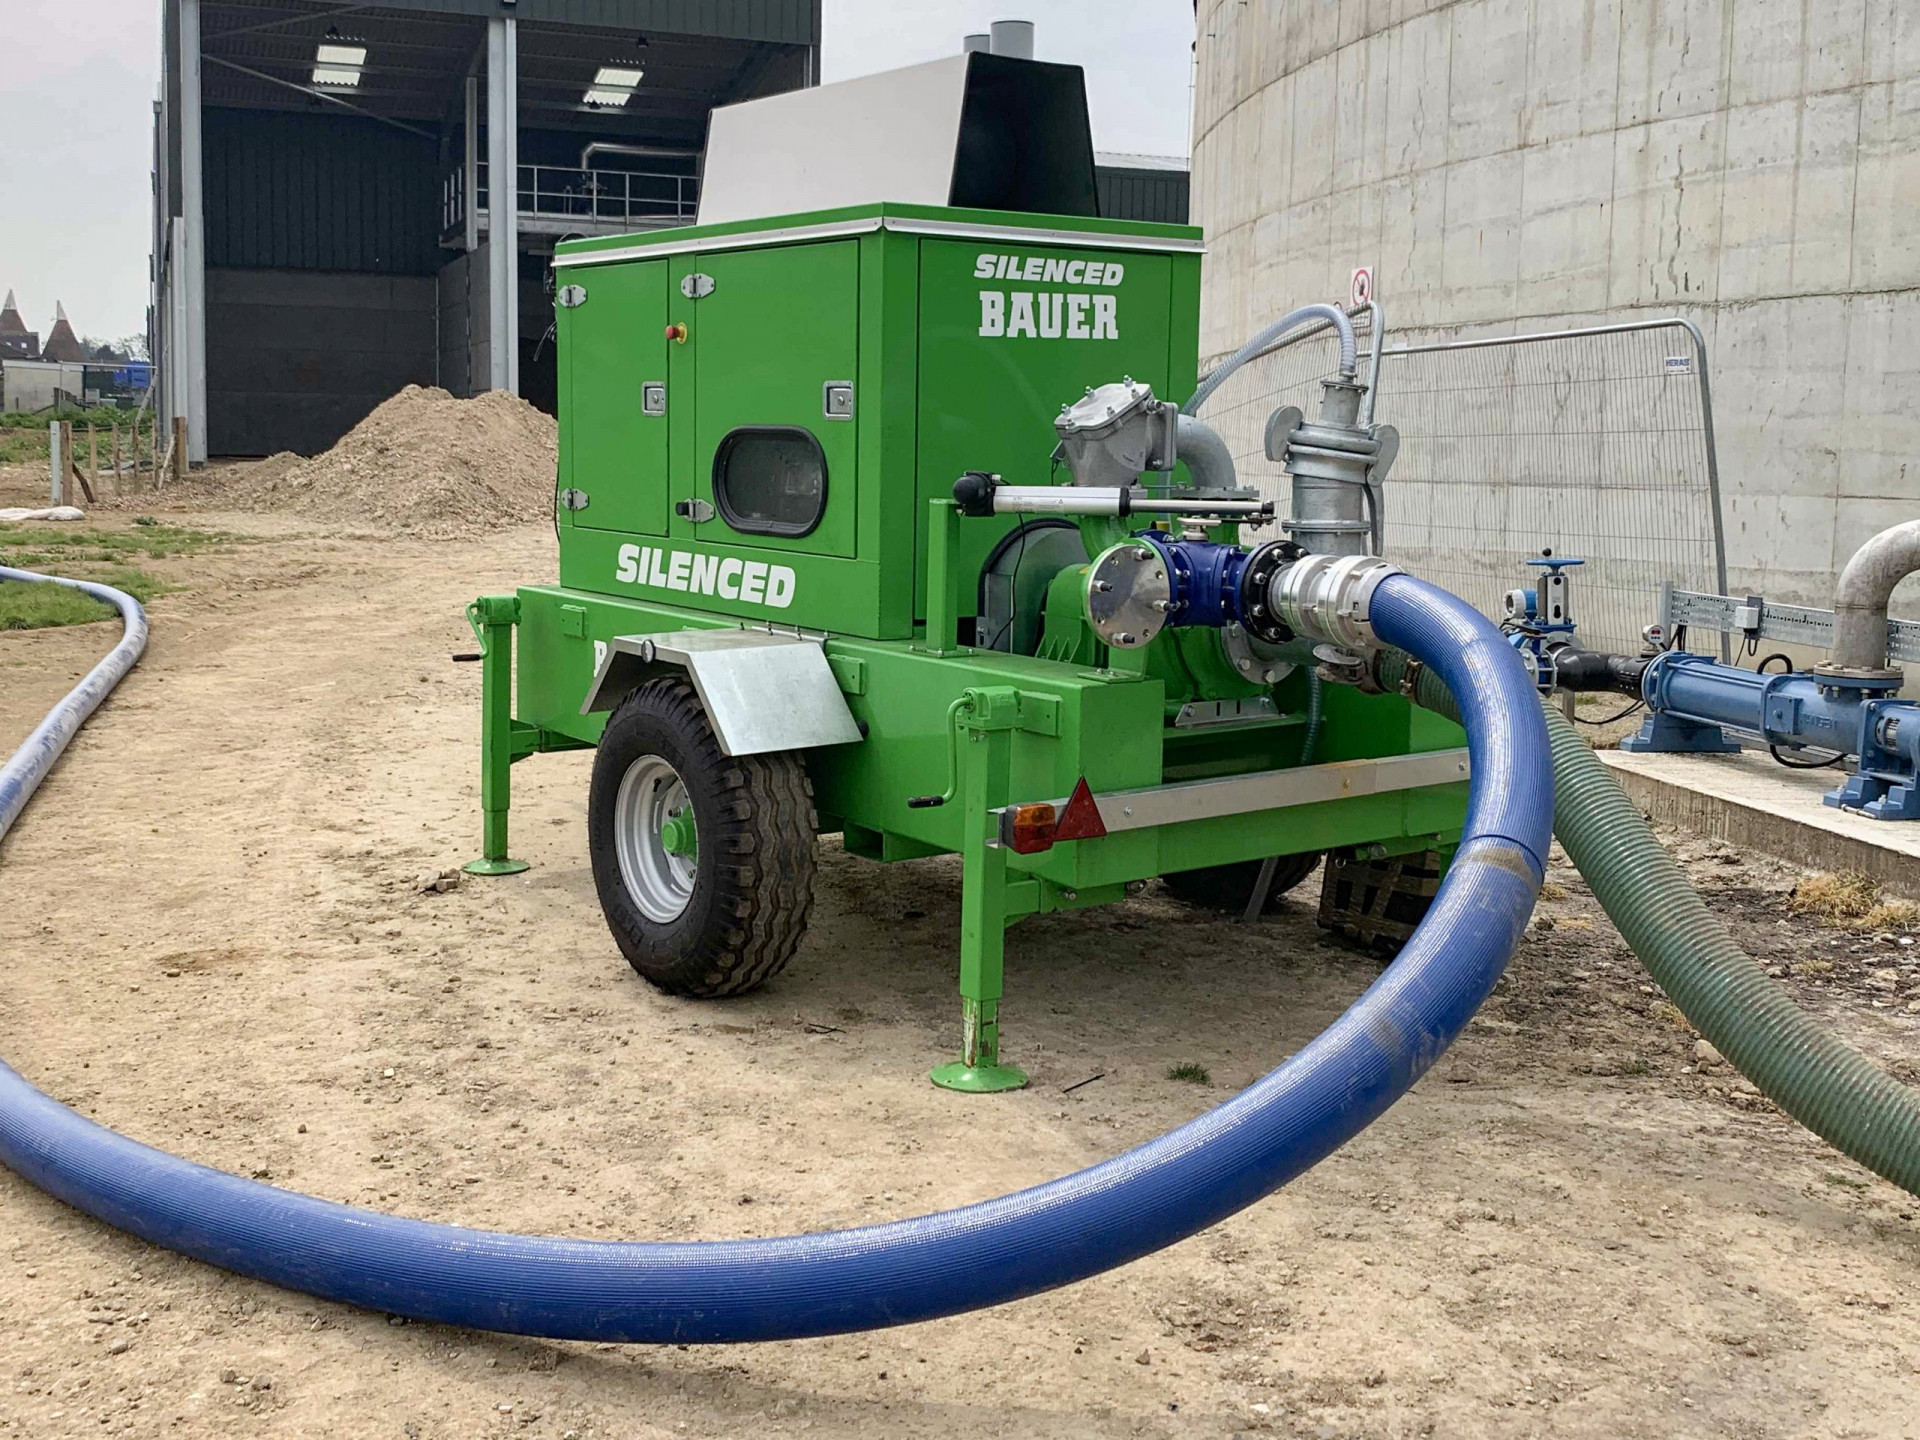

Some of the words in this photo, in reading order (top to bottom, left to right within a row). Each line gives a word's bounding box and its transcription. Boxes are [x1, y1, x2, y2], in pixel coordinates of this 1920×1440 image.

[974, 254, 1124, 286] SILENCED
[979, 291, 1119, 340] BAUER
[616, 543, 796, 609] SILENCED
